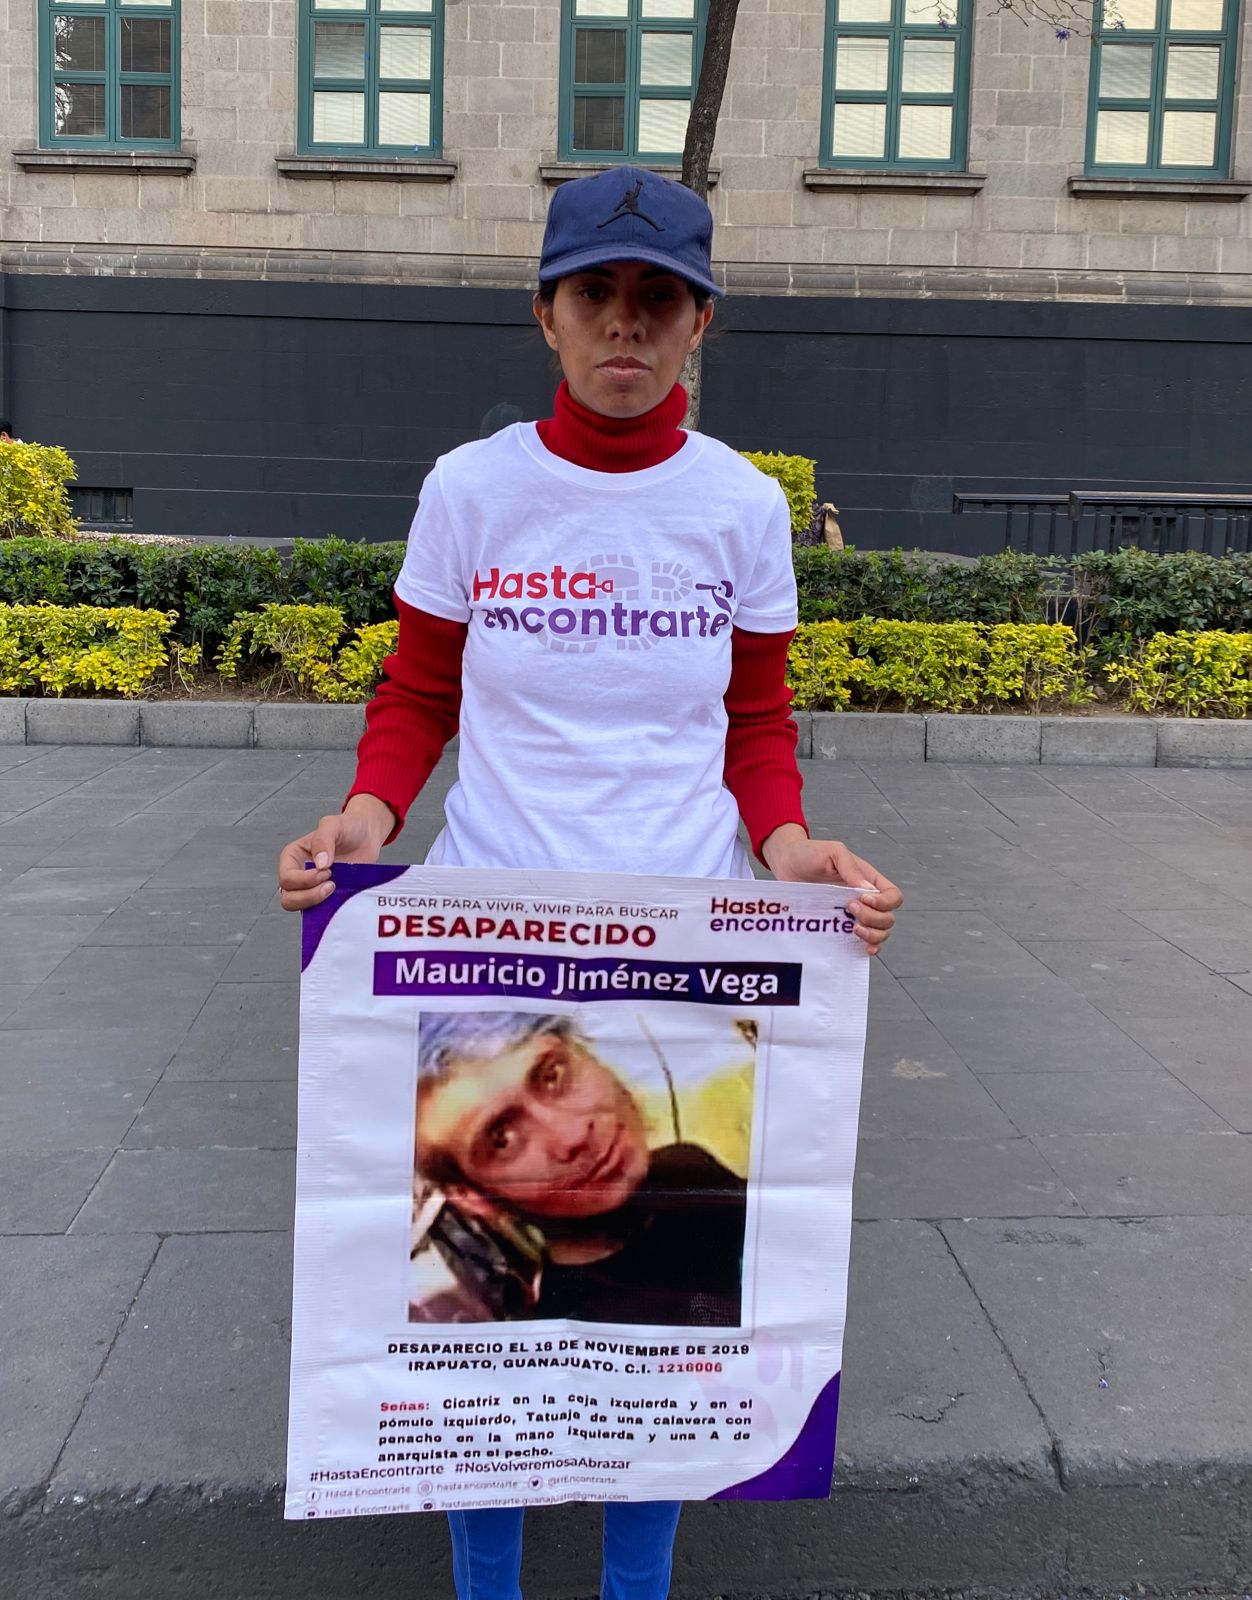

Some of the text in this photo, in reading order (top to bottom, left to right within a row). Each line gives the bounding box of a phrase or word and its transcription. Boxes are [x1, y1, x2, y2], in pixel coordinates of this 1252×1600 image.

[473, 565, 597, 601] Hasta
[482, 602, 730, 637] encontrarte
[378, 896, 679, 920] BUSCAR PARA VIVIR, VIVIR PARA BUSCAR
[711, 897, 782, 915] Hasta
[378, 914, 657, 948] DESAPARECIDO
[710, 915, 855, 934] encontrarte
[395, 957, 779, 1001] Mauricio Jiménez Vega
[387, 1343, 503, 1354] DESAPARECIO
[509, 1342, 529, 1353] EL
[559, 1339, 579, 1351] DE
[585, 1340, 680, 1356] NOVIEMBRE
[686, 1345, 706, 1355] DE
[711, 1344, 750, 1355] 2019
[408, 1359, 497, 1372] IRAPUATO,
[380, 1401, 430, 1412] Señas:
[443, 1395, 501, 1410] Cicatriz
[512, 1395, 530, 1405] en
[542, 1394, 556, 1405] la
[567, 1393, 598, 1407] ceja
[610, 1396, 678, 1410] izquierda
[690, 1400, 698, 1411] y
[710, 1401, 727, 1410] en
[379, 1410, 752, 1430] pómulo izquierdo, Tatuaje de una calavera con
[378, 1425, 751, 1446] penacho en la mano izquierda y una A de
[378, 1449, 458, 1463] anarquista
[310, 1464, 445, 1482] #HastaEncontrarte
